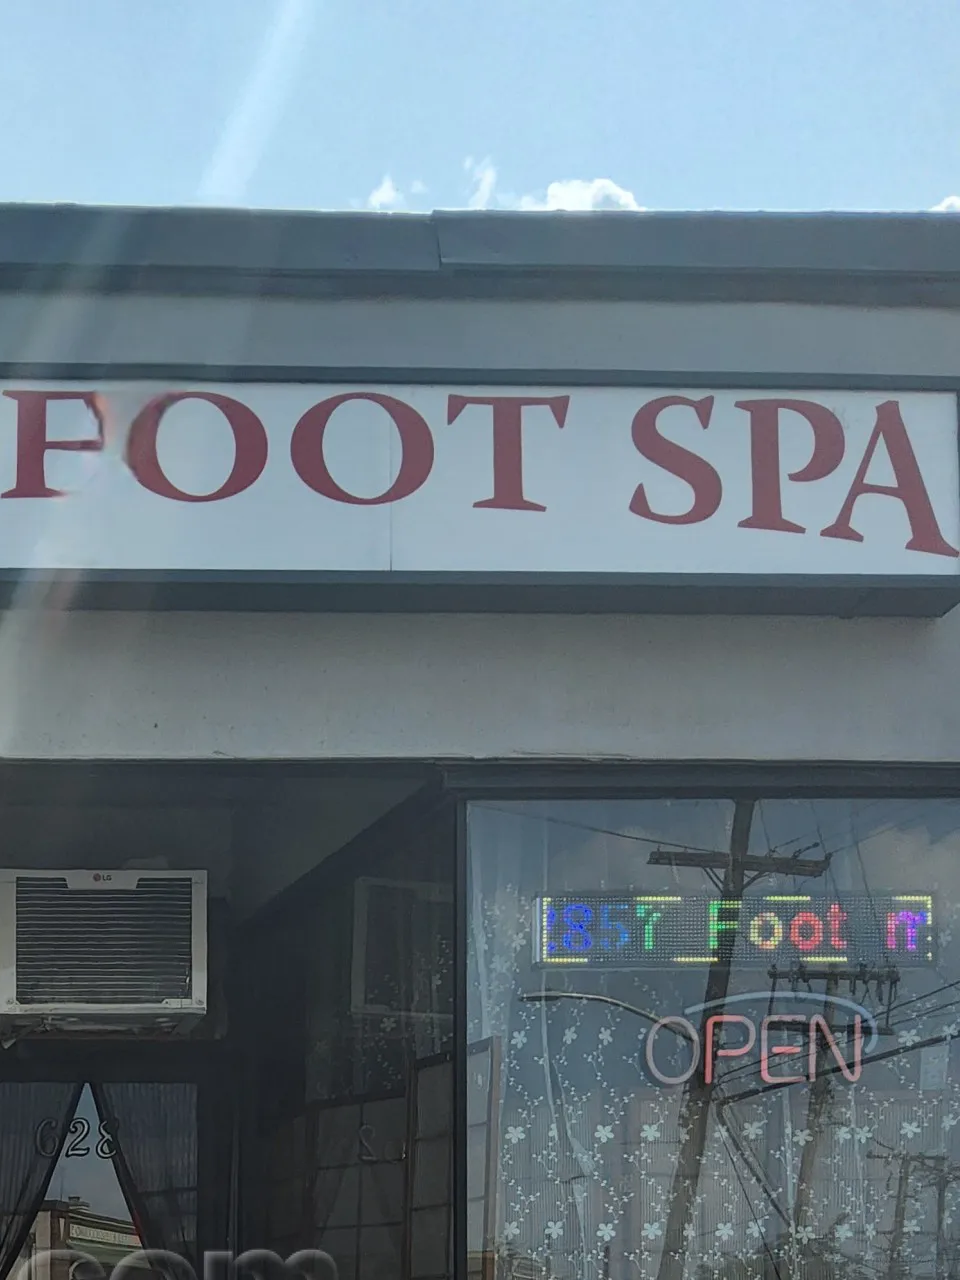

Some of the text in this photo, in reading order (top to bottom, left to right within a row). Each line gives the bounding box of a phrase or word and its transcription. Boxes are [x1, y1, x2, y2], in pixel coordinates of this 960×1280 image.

[0, 391, 571, 512] FOOT
[629, 395, 960, 559] SPA
[708, 901, 847, 950] Foot
[645, 1014, 861, 1084] OPEN
